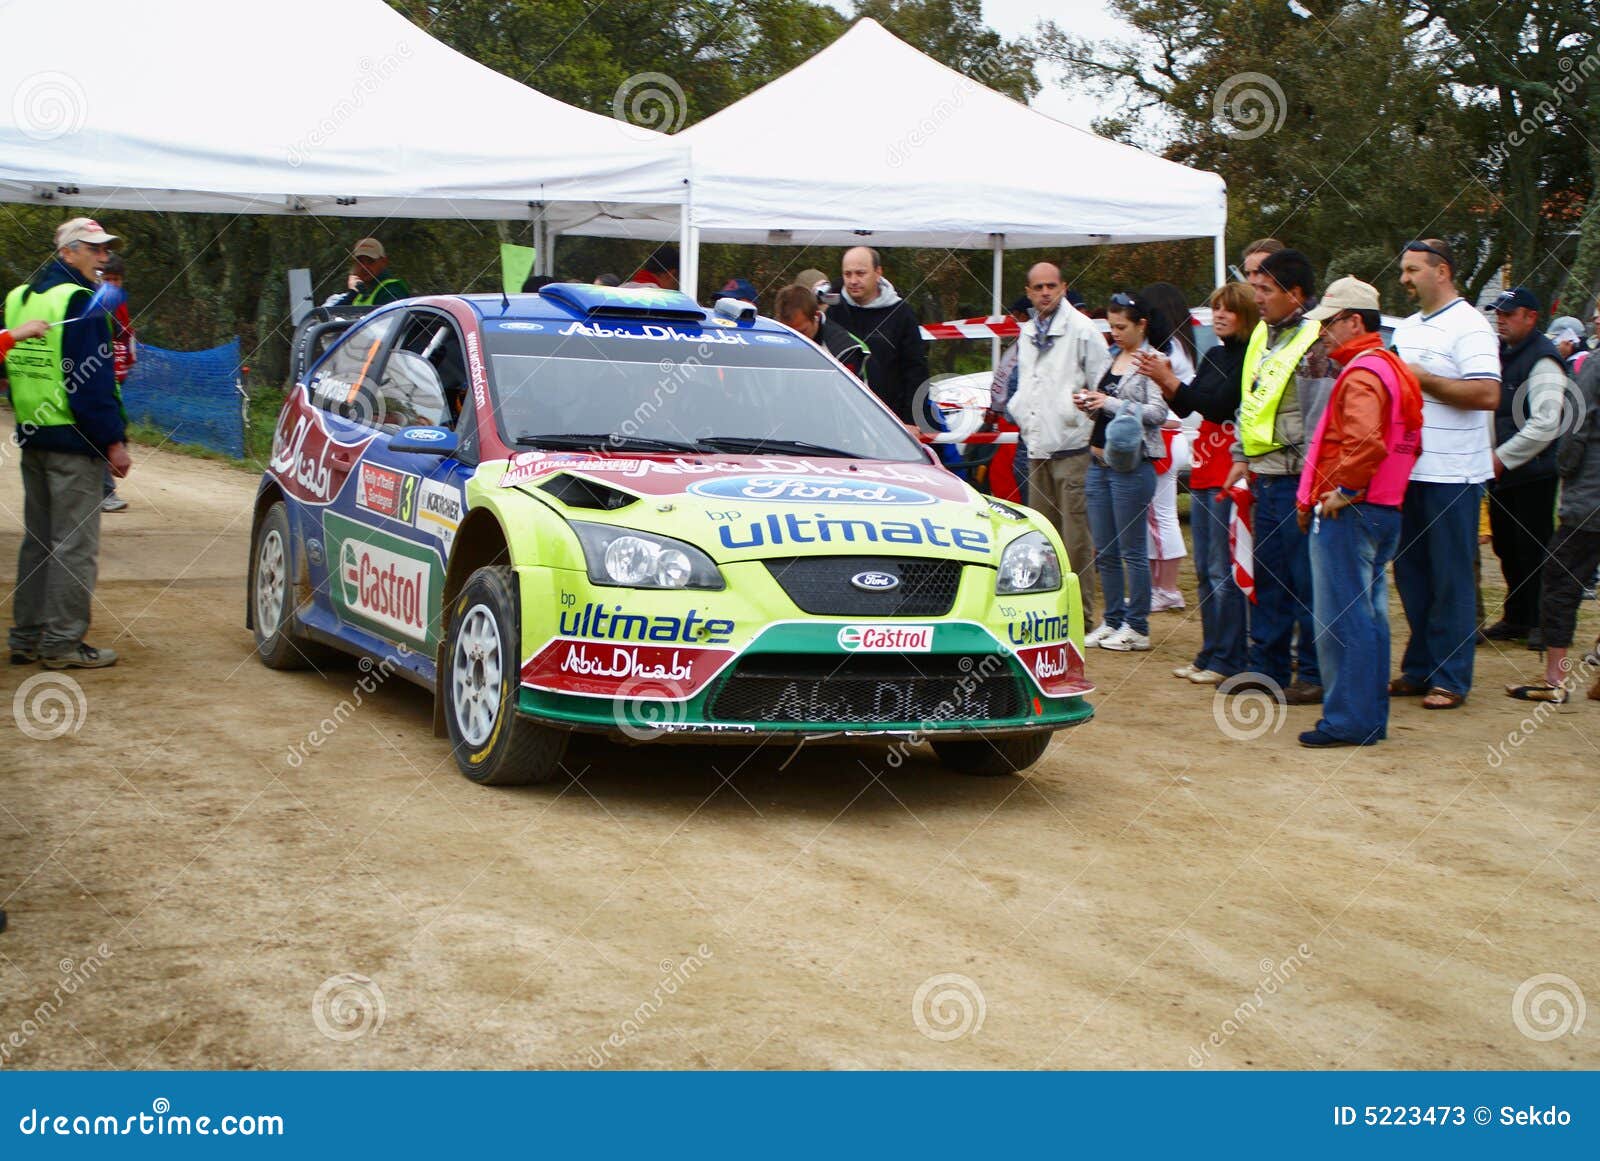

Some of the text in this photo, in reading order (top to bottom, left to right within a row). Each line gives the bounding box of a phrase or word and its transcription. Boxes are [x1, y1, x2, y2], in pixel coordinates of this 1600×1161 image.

[559, 321, 639, 339] Abu
[409, 430, 441, 441] Ford
[402, 476, 415, 522] 3
[742, 476, 897, 501] Ford
[706, 510, 743, 523] bp
[718, 513, 991, 554] ultimate
[360, 552, 423, 629] Castrol
[561, 589, 577, 608] bp
[1000, 604, 1017, 618] bp
[560, 603, 736, 644] ultimate
[863, 628, 927, 649] Castrol
[561, 644, 693, 681] Abu Dhabi
